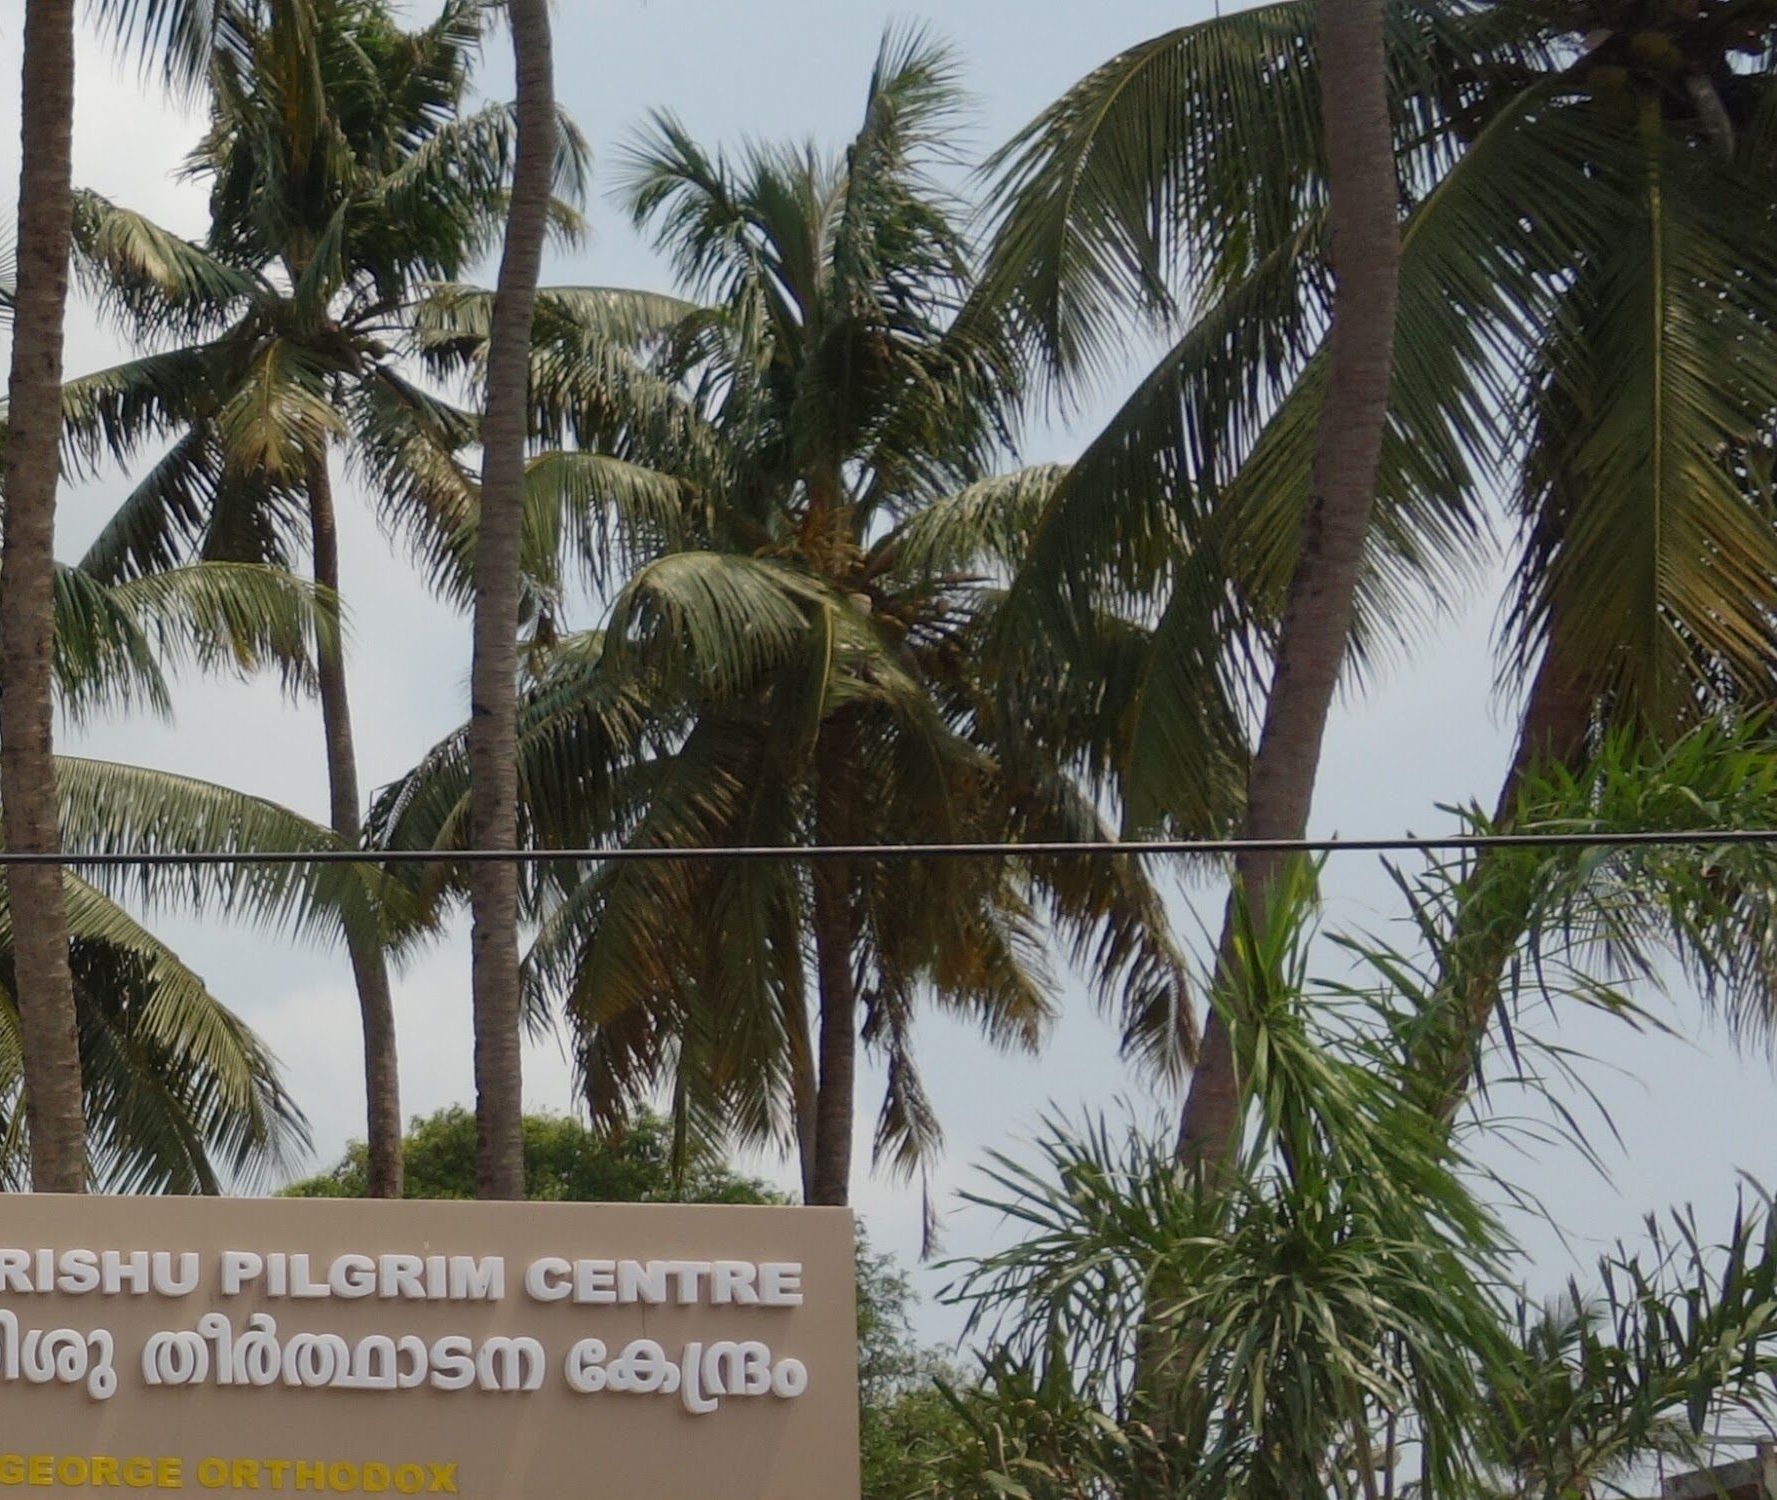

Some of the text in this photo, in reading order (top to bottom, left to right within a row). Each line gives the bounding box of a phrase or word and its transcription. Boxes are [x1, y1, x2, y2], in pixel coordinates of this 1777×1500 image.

[220, 1250, 505, 1300] PILGRIM
[524, 1257, 804, 1306] CENTRE
[197, 1457, 458, 1493] ORTHODOX
